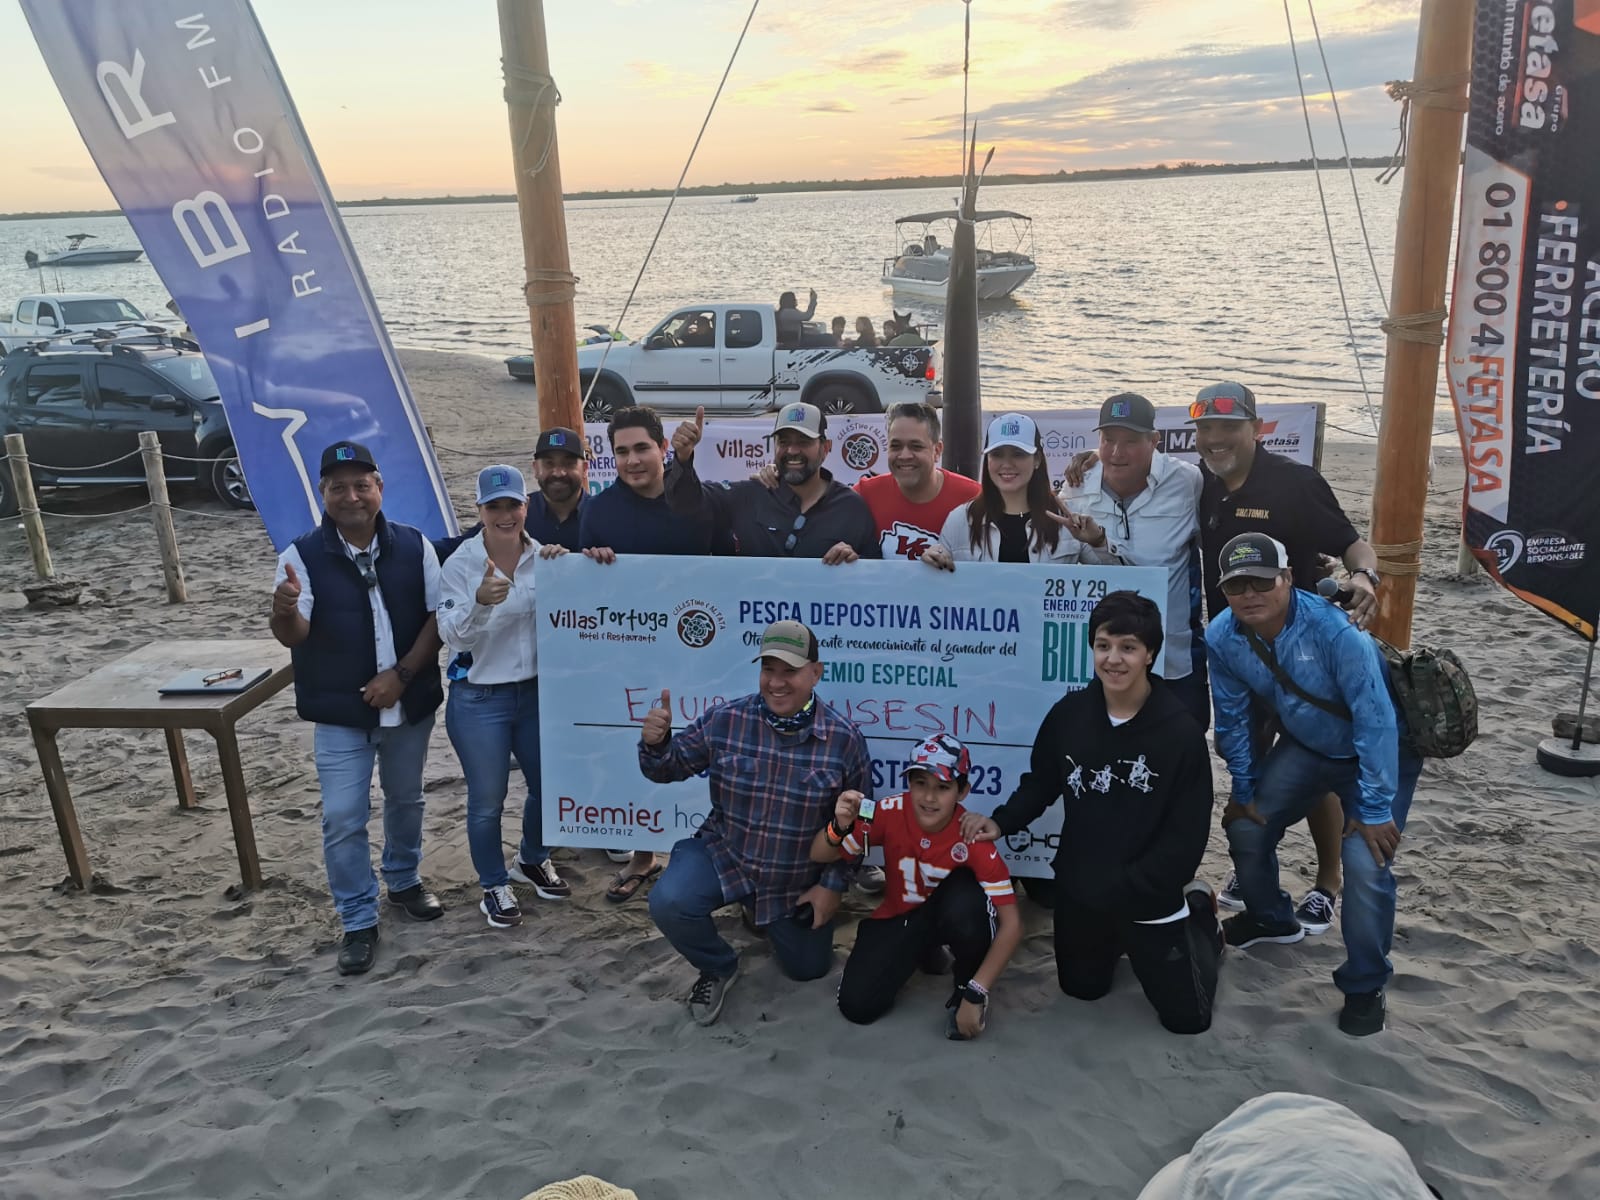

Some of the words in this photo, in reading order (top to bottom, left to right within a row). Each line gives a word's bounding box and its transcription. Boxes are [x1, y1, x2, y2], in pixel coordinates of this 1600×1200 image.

[175, 13, 232, 90] FM
[1500, 17, 1515, 70] mundo
[1519, 0, 1559, 129] etasa
[233, 127, 323, 299] RADIO
[1525, 214, 1579, 455] FERRETERÍA
[1526, 537, 1566, 547] EMPRESA
[1526, 543, 1585, 555] SOCIALMENTE
[1526, 551, 1585, 564] RESPONSABLE
[1045, 579, 1065, 597] 28
[1072, 580, 1081, 598] Y
[1087, 580, 1107, 598] 29
[740, 600, 803, 625] PESCA
[810, 602, 922, 629] DEPOSTIVA
[929, 605, 1020, 633] SINALOA
[1044, 599, 1077, 612] ENERO
[579, 631, 599, 642] Hotel
[846, 637, 927, 652] reconocimiento
[930, 638, 942, 654] al
[941, 641, 995, 662] ganador
[999, 642, 1017, 656] del
[872, 663, 958, 688] ESPECIAL
[559, 797, 665, 834] Premier
[559, 825, 634, 837] AUTOMOTRIZ
